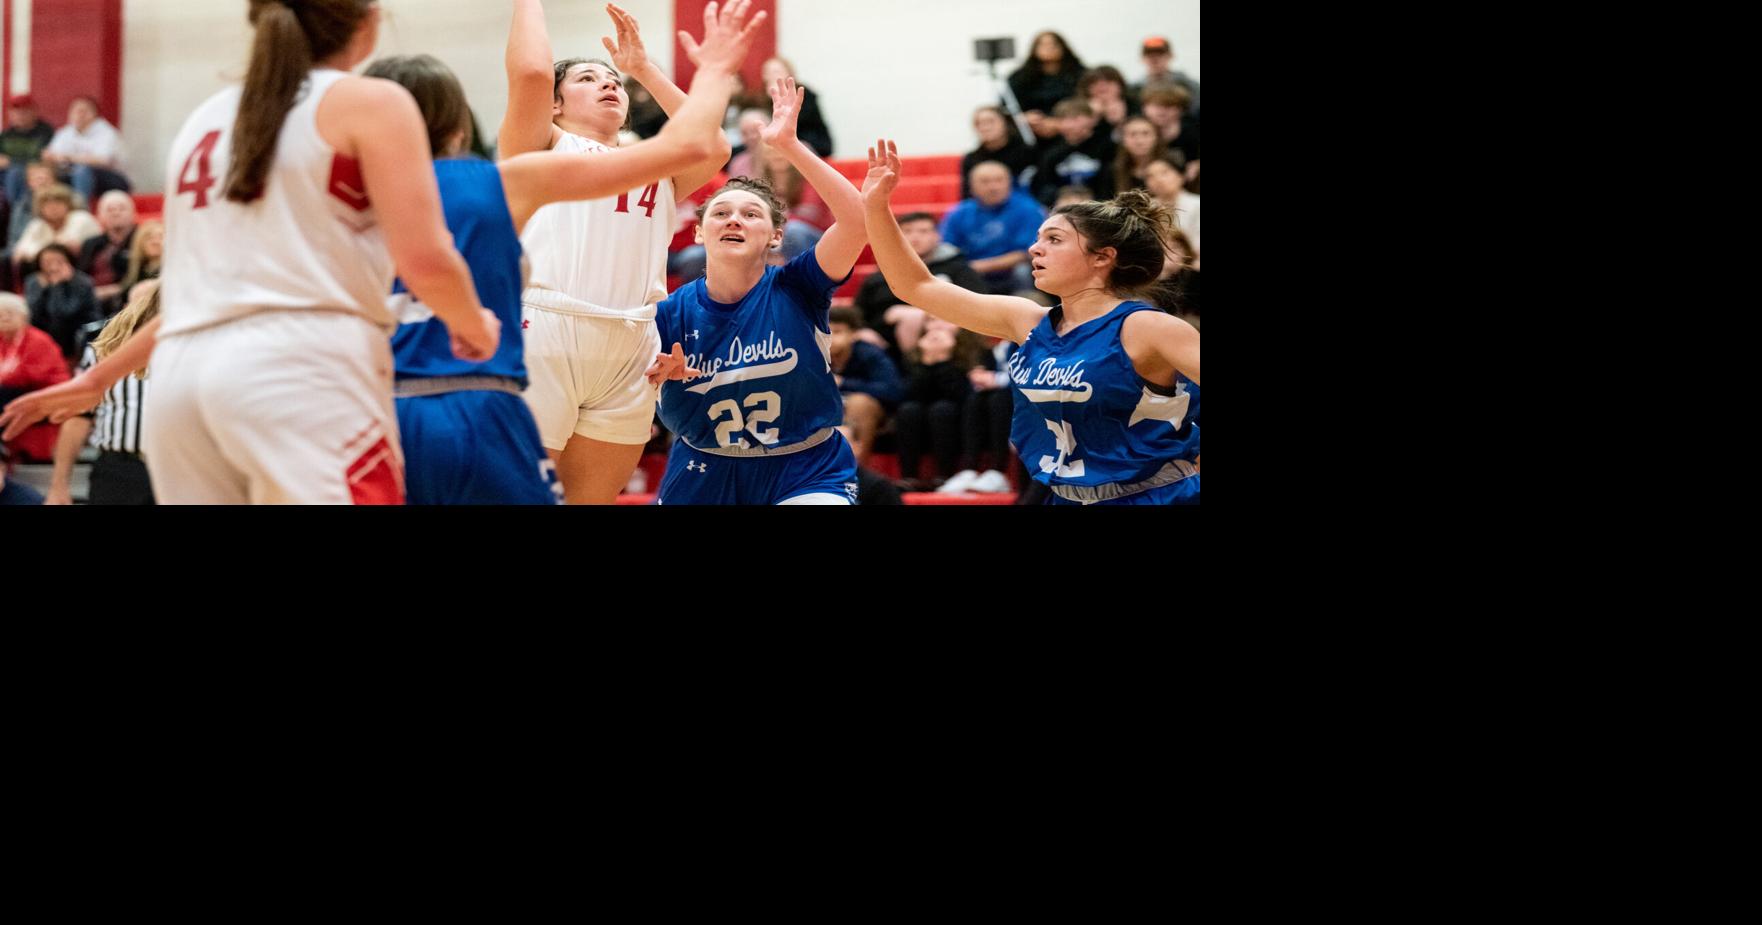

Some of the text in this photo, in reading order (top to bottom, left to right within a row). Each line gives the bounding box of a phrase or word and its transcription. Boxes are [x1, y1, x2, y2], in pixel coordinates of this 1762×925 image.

[177, 130, 221, 210] 4
[614, 181, 659, 217] 14
[724, 331, 786, 367] Devils
[707, 391, 781, 449] 22
